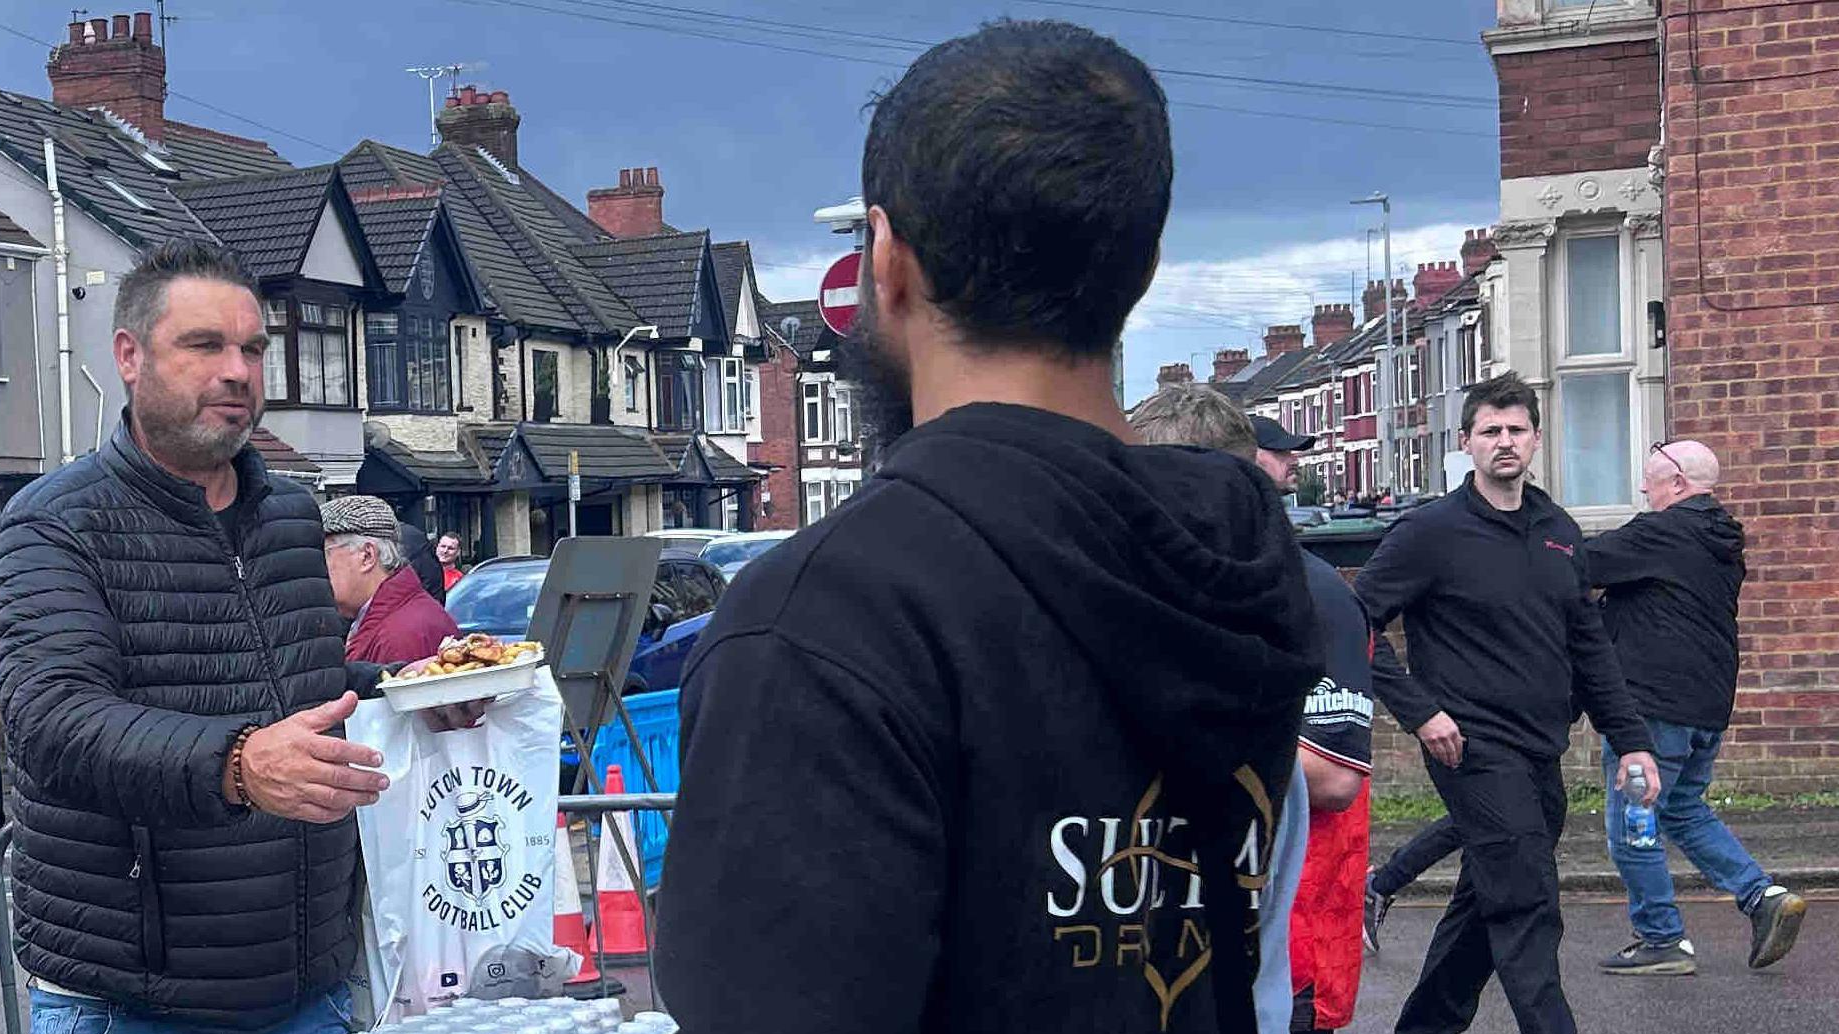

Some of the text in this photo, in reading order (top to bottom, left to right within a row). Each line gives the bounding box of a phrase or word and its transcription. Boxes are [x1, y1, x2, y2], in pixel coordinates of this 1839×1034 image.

[420, 766, 533, 822] LUTON TOWN
[525, 836, 550, 847] 1885
[423, 873, 542, 932] FOOTBALL CLUB
